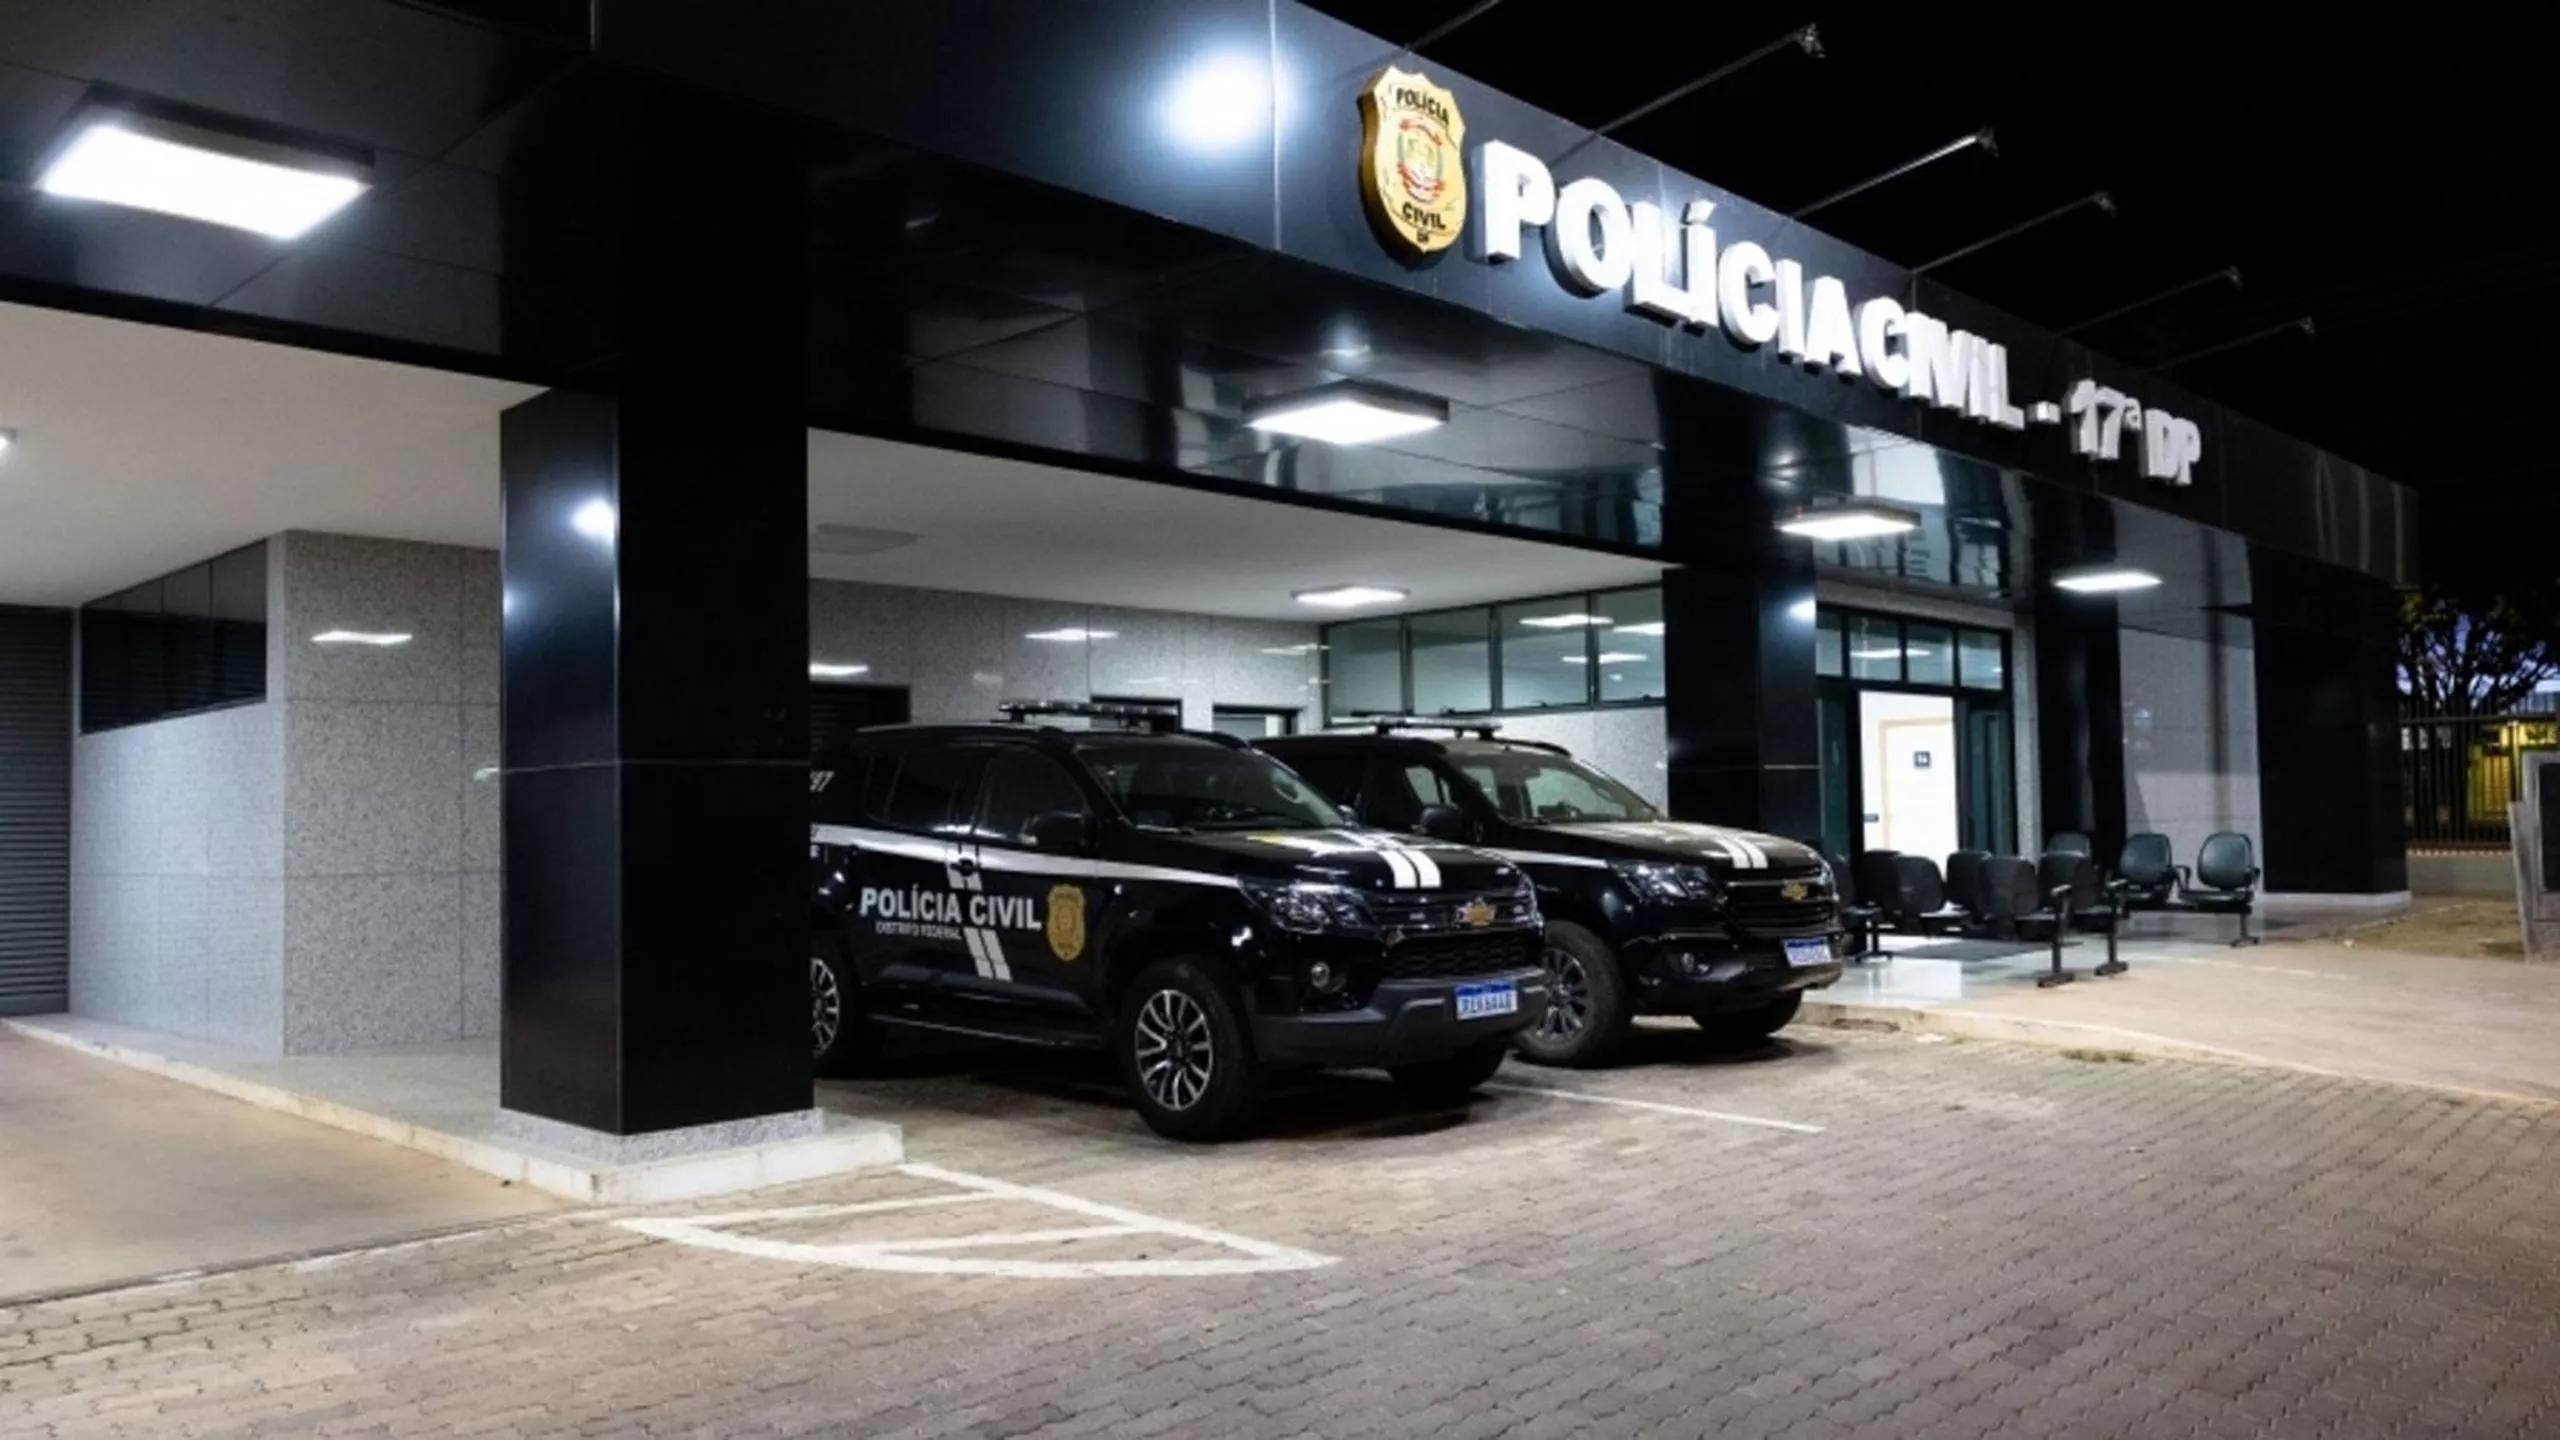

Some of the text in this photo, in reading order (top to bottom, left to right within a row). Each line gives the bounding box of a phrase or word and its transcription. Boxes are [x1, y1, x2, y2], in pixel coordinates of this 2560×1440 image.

[1396, 87, 1450, 126] POLÍCIA
[1402, 202, 1447, 230] CIVIL
[1472, 138, 1863, 378] POLÍCIA
[1854, 296, 2025, 431] CIVIL
[2141, 407, 2201, 486] DP
[858, 883, 1043, 931] POLÍCIA CIVIL
